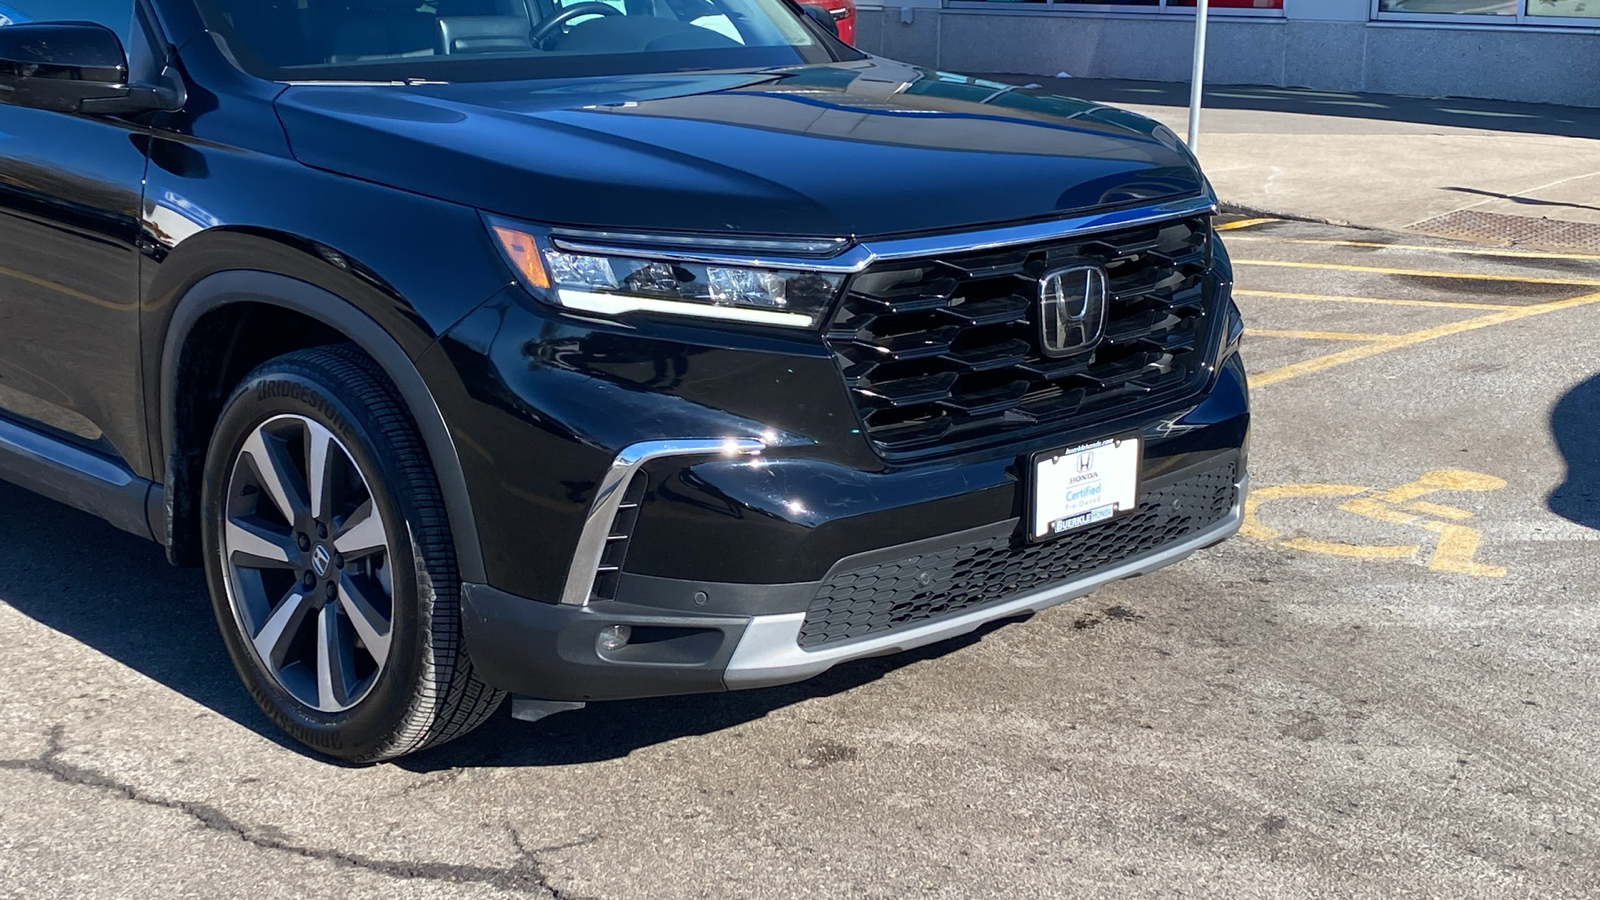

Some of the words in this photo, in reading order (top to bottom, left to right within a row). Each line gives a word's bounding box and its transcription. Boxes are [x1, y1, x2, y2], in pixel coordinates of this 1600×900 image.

[1069, 471, 1099, 484] HONDA
[1066, 483, 1101, 501] Certified
[1065, 496, 1101, 511] Pre-Owned
